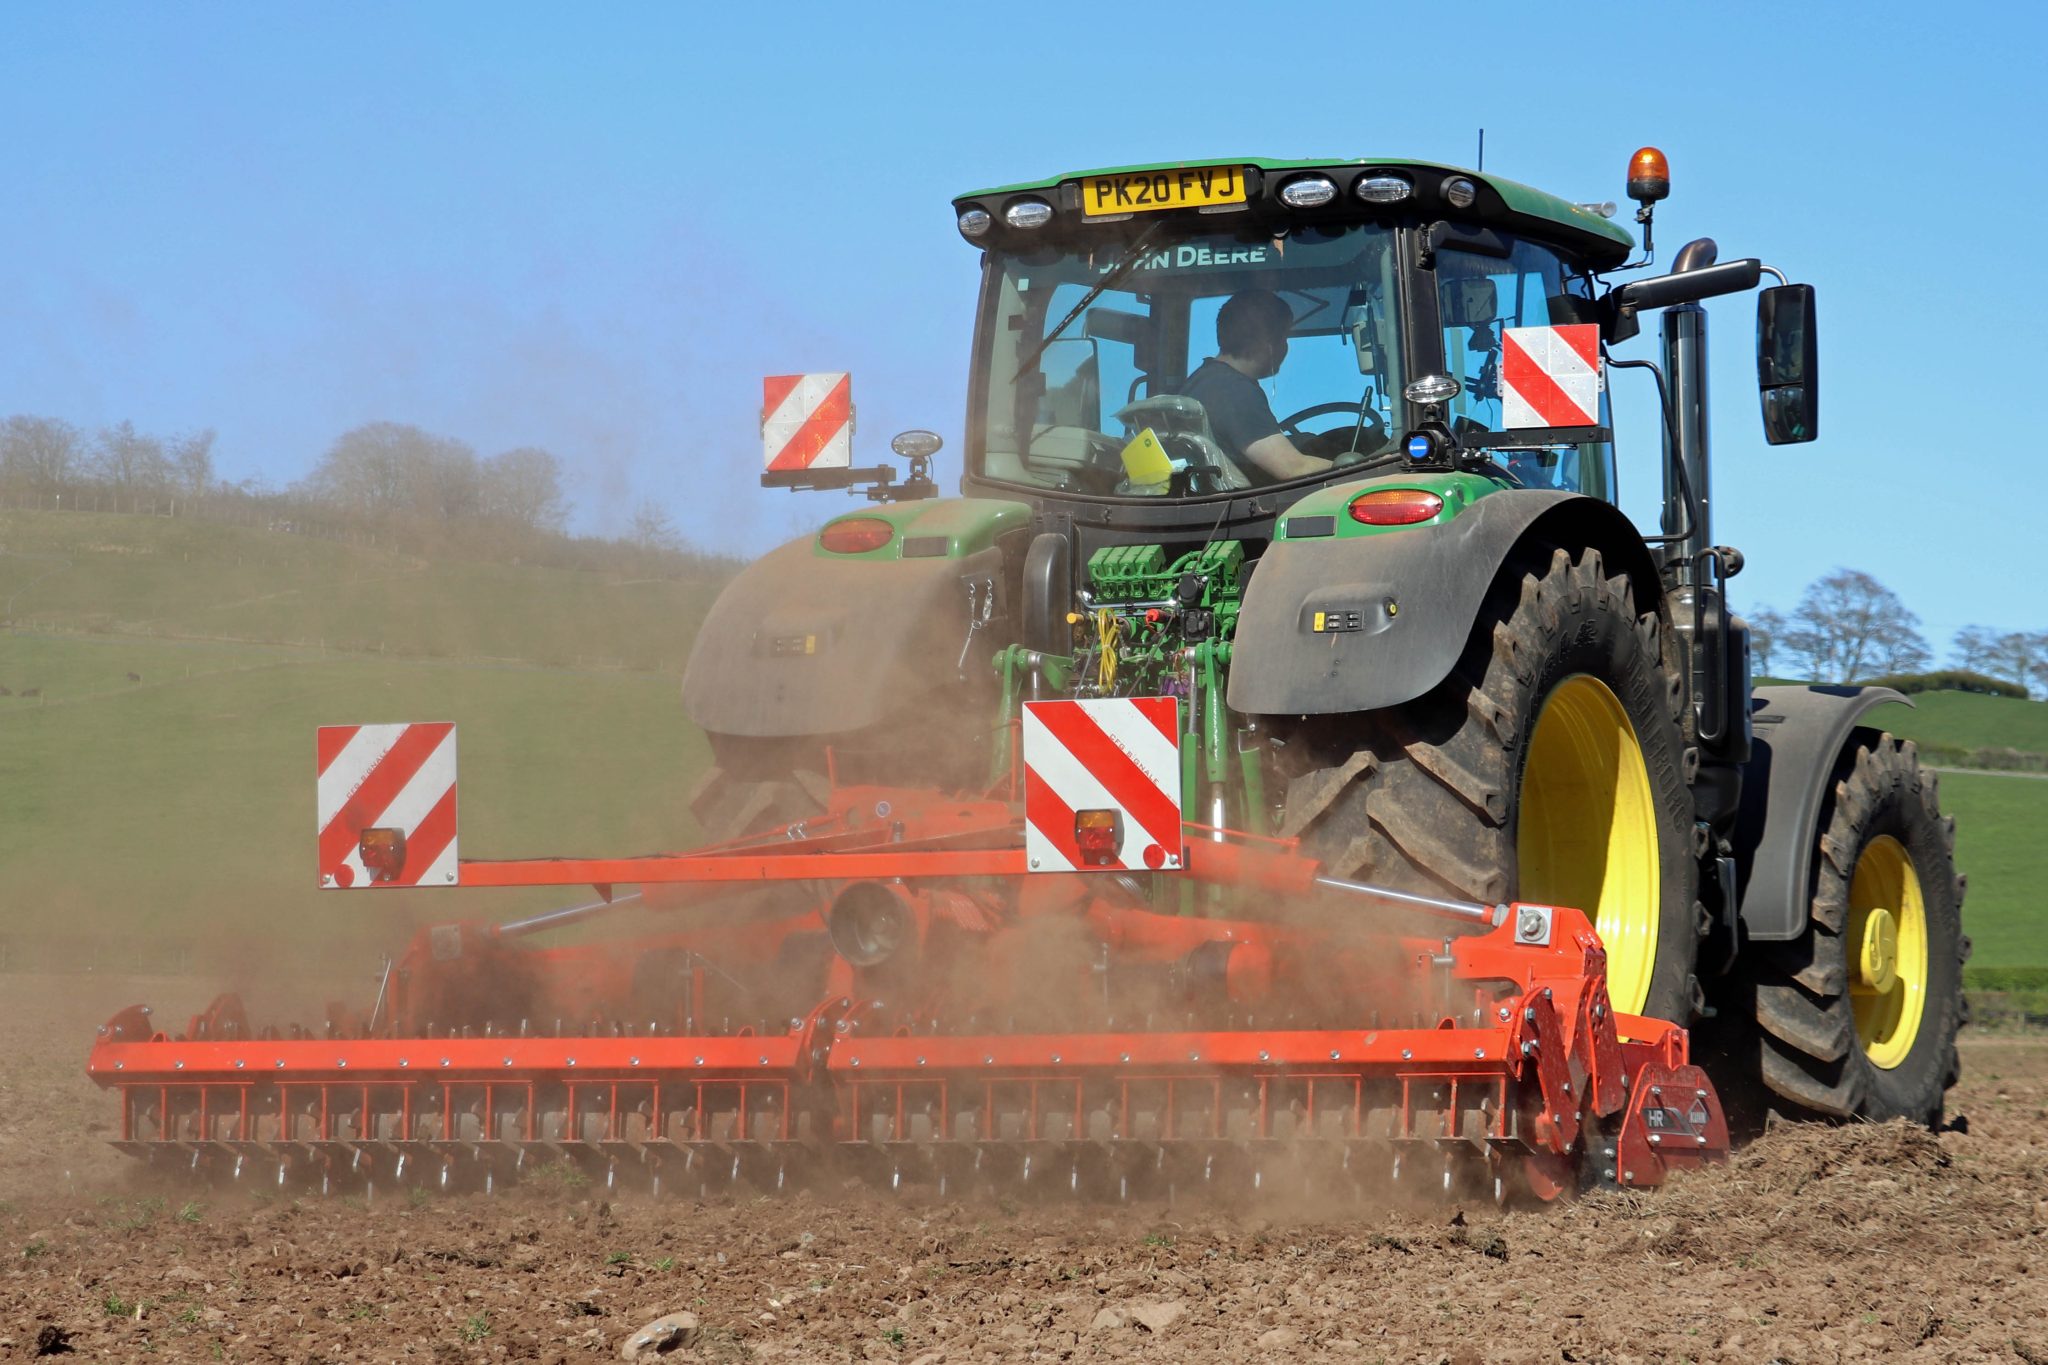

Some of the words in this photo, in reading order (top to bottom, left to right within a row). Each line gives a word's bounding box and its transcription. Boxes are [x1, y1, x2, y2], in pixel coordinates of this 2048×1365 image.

[1095, 174, 1170, 208] PK20
[1178, 168, 1234, 200] FVJ
[1177, 246, 1266, 267] DEERE
[1648, 1109, 1664, 1127] HR
